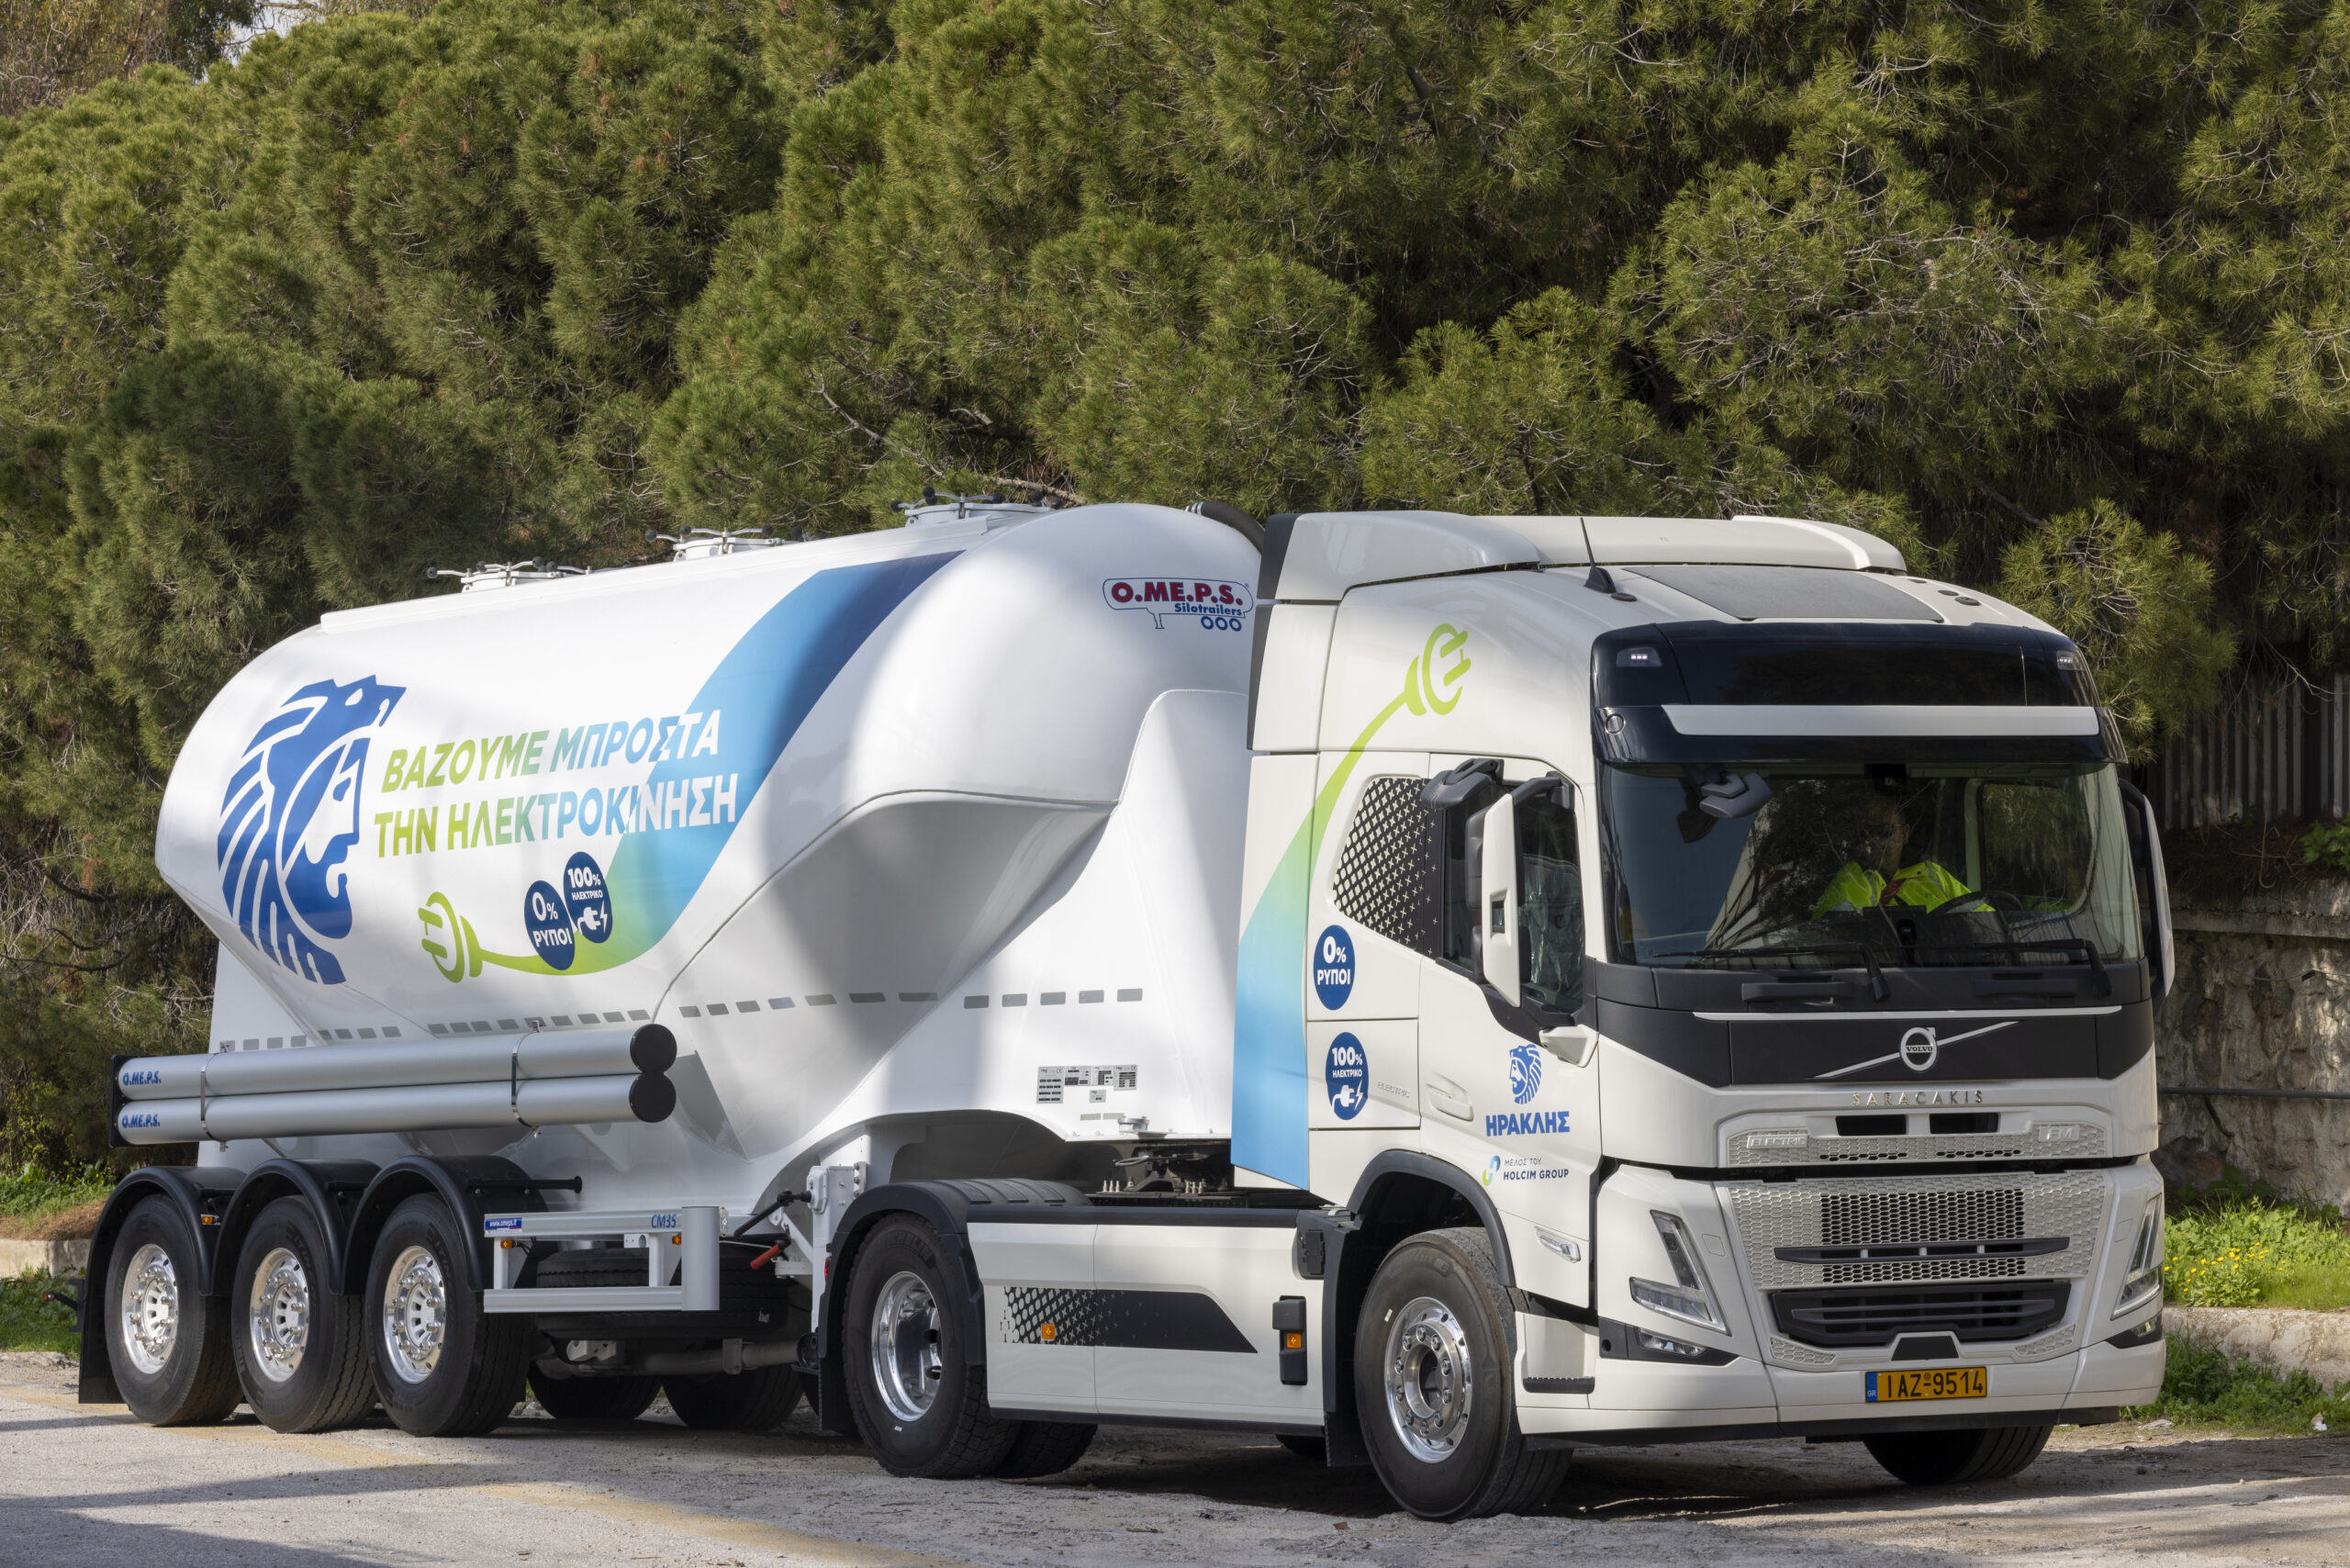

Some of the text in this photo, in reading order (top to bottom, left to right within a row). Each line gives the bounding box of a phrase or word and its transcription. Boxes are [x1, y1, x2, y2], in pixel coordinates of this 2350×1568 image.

[1111, 581, 1243, 606] O.ME.P.S.
[1174, 602, 1242, 616] Silotrailers
[381, 710, 721, 793] ΒΑΖΟΥΜΕ ΜΠΡΟΣΤΑ
[375, 773, 738, 858] ΤΗΝ ΗΛΕΚΤΡΟΚΙΝΗΣΗ
[567, 867, 601, 889] 100%
[571, 890, 603, 901] ΗΛΕΚΤΡΙΚΟ
[532, 891, 558, 922] 0%
[532, 927, 573, 947] ΡΥΠΟΙ
[1323, 935, 1347, 963] 0%
[1317, 969, 1351, 985] ΡΥΠΟΙ
[1332, 1047, 1362, 1067] 100%
[122, 1070, 162, 1086] O.ME.P.S.
[1332, 1069, 1362, 1078] ΗΛΕΚΤΡΙΚΟ
[1852, 1090, 1983, 1107] SARACAKIS
[121, 1114, 161, 1129] O.ME.P.S.
[1485, 1111, 1571, 1137] ΗΡΑΚΛΗΣ
[2046, 1127, 2073, 1140] FM
[1751, 1137, 1806, 1147] ELECTRIC
[1504, 1158, 1542, 1167] ΜΕΛΟΣ ΤΟΥ
[1503, 1169, 1569, 1181] HOLCIM GROUP
[489, 1219, 517, 1227] www.omeps.it
[651, 1214, 677, 1229] CM35
